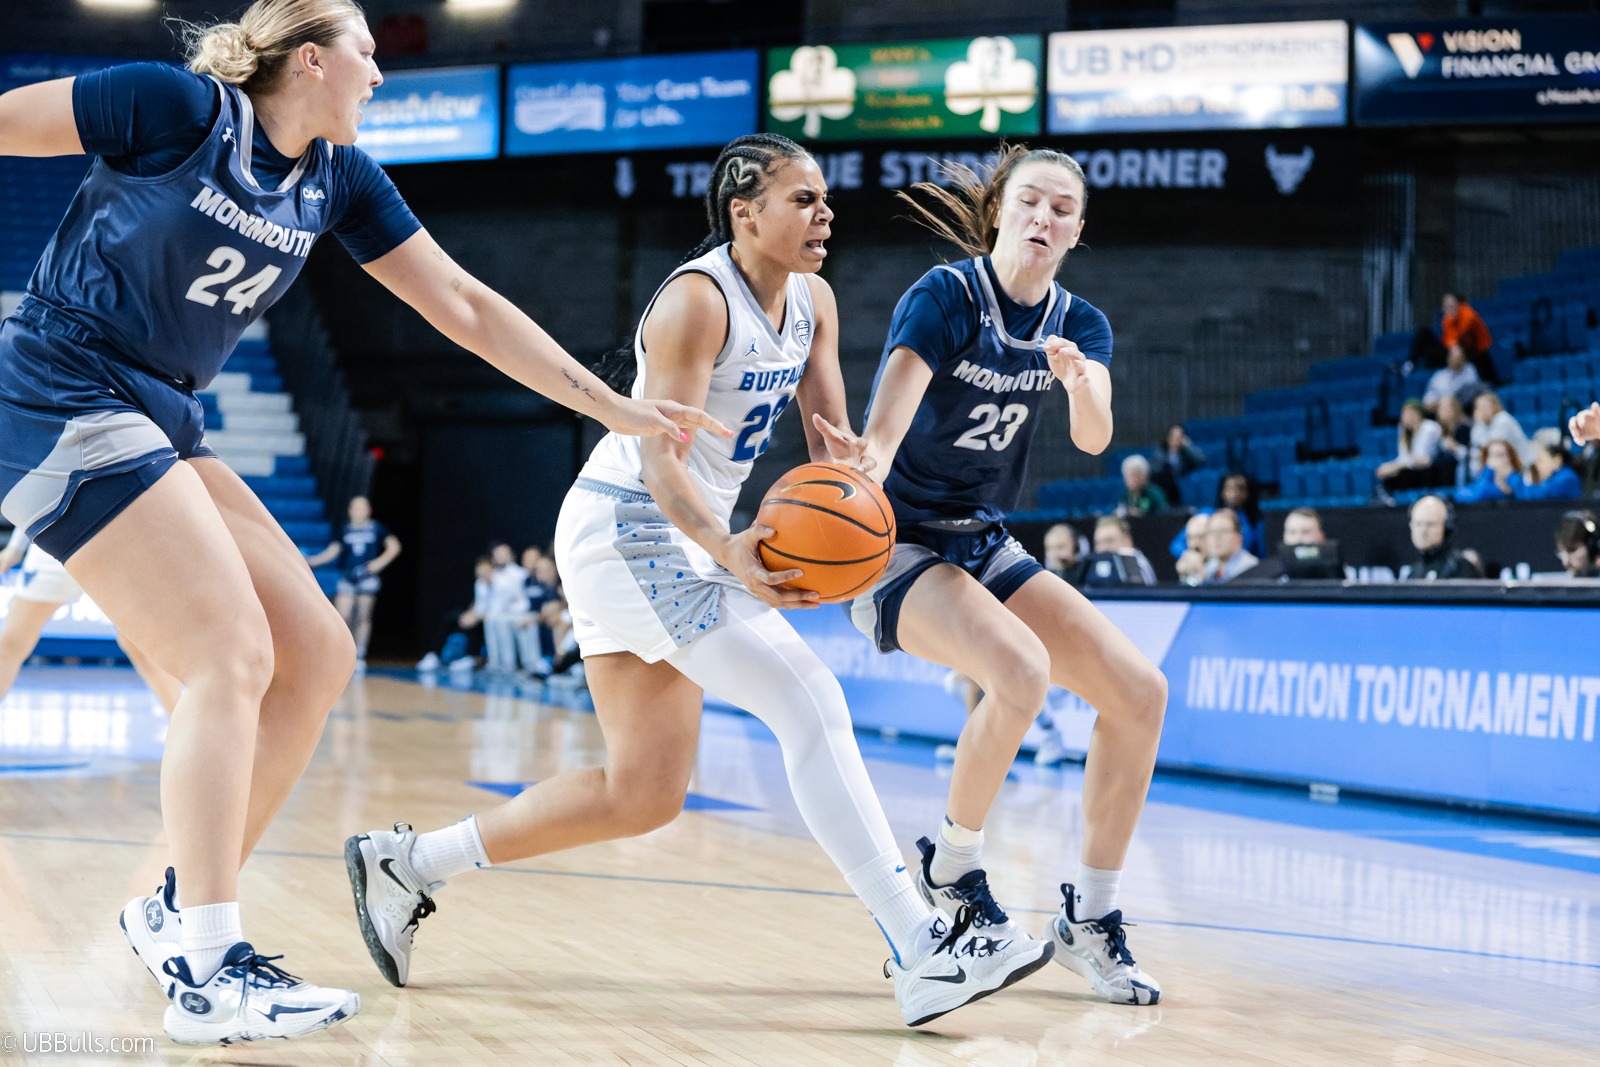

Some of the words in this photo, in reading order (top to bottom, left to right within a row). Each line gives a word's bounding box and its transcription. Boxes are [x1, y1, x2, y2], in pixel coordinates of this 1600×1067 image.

[1057, 45, 1110, 76] UB
[1441, 53, 1560, 79] FINANCIAL
[1564, 51, 1600, 75] GR
[1442, 28, 1522, 54] VISION
[302, 187, 326, 201] CAA
[665, 162, 713, 197] TR
[818, 150, 863, 190] UE
[879, 149, 994, 189] STUD
[190, 186, 316, 258] MONMOUTH
[185, 246, 282, 315] 24
[953, 403, 1029, 451] 23
[1186, 656, 1352, 722] INVITATION
[1355, 663, 1600, 742] TOURNAMENT
